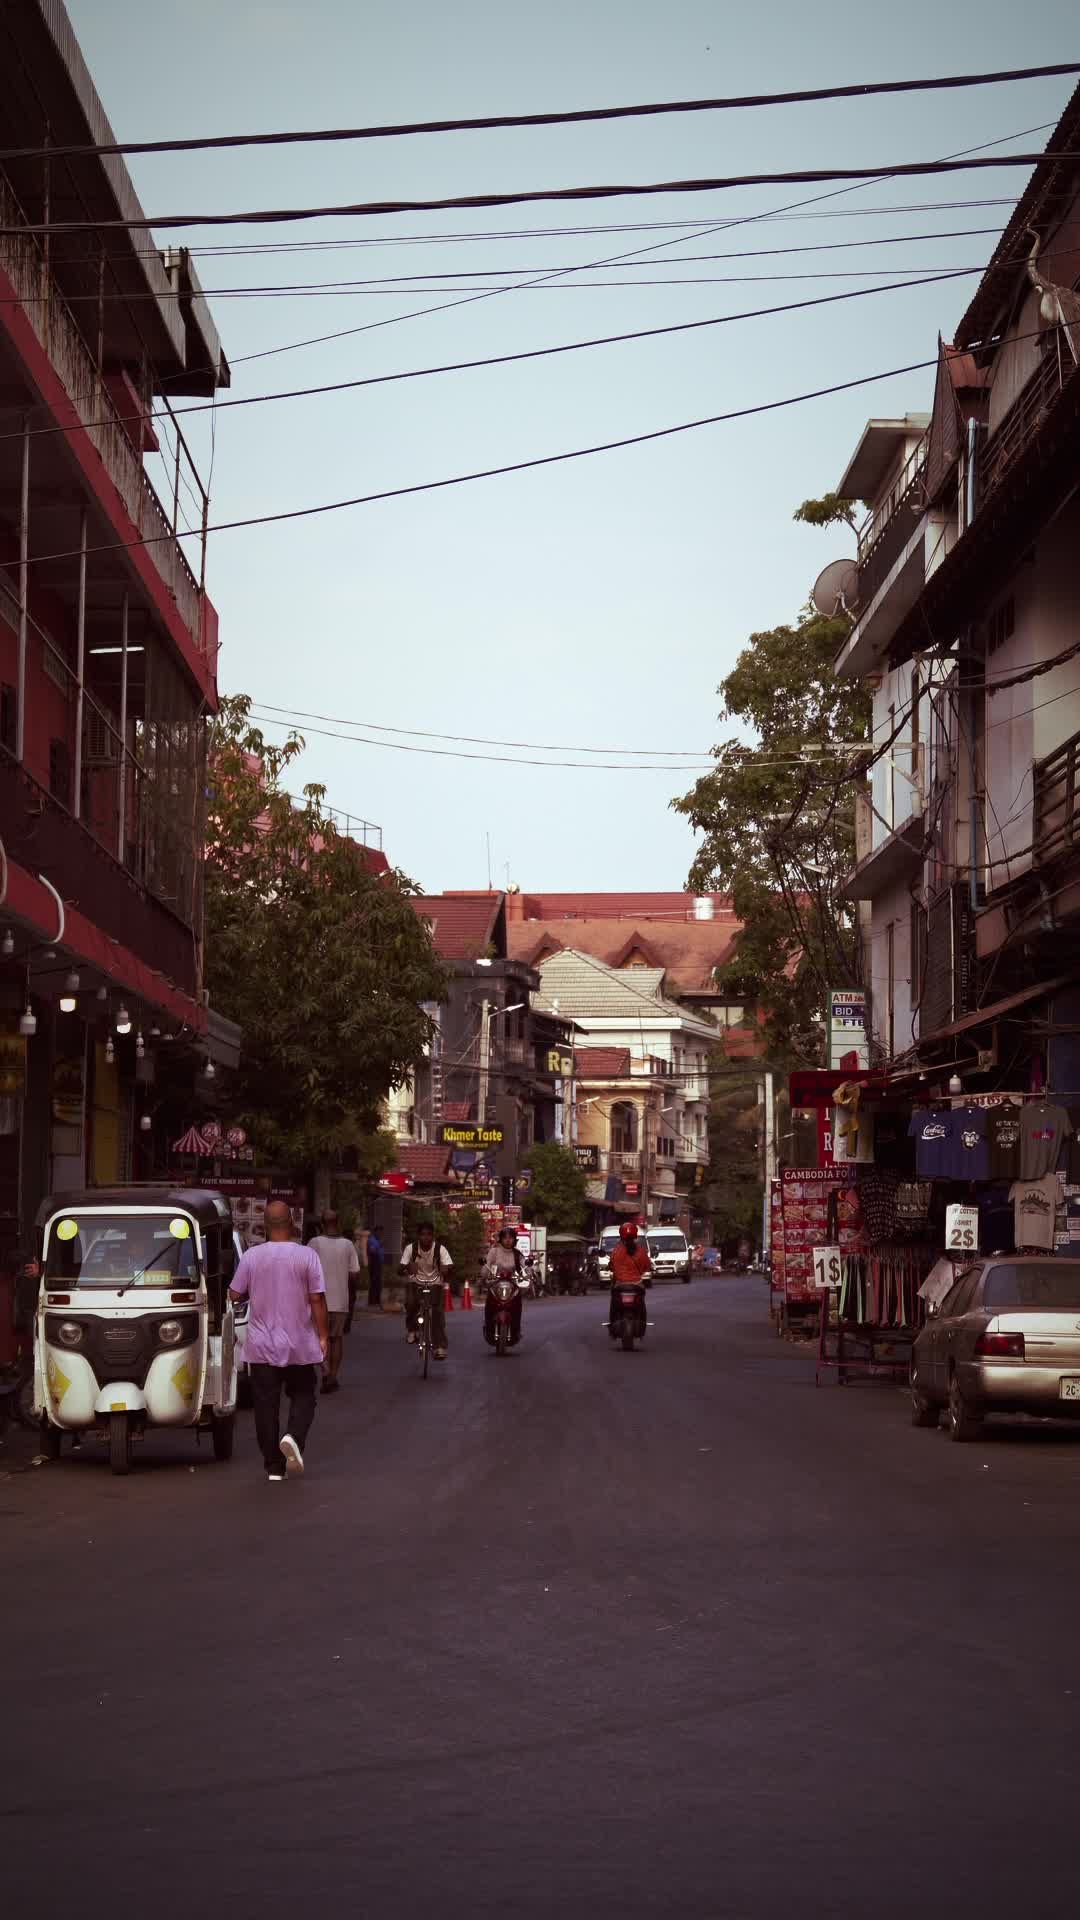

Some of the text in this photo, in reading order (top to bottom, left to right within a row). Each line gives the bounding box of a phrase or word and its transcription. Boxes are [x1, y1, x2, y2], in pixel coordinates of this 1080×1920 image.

[832, 993, 853, 1002] ATM
[835, 1007, 853, 1016] BID
[443, 1127, 504, 1141] Khmer Taste
[784, 1170, 833, 1180] CAMBODIA
[950, 1229, 974, 1249] 2$
[816, 1256, 840, 1285] 1$
